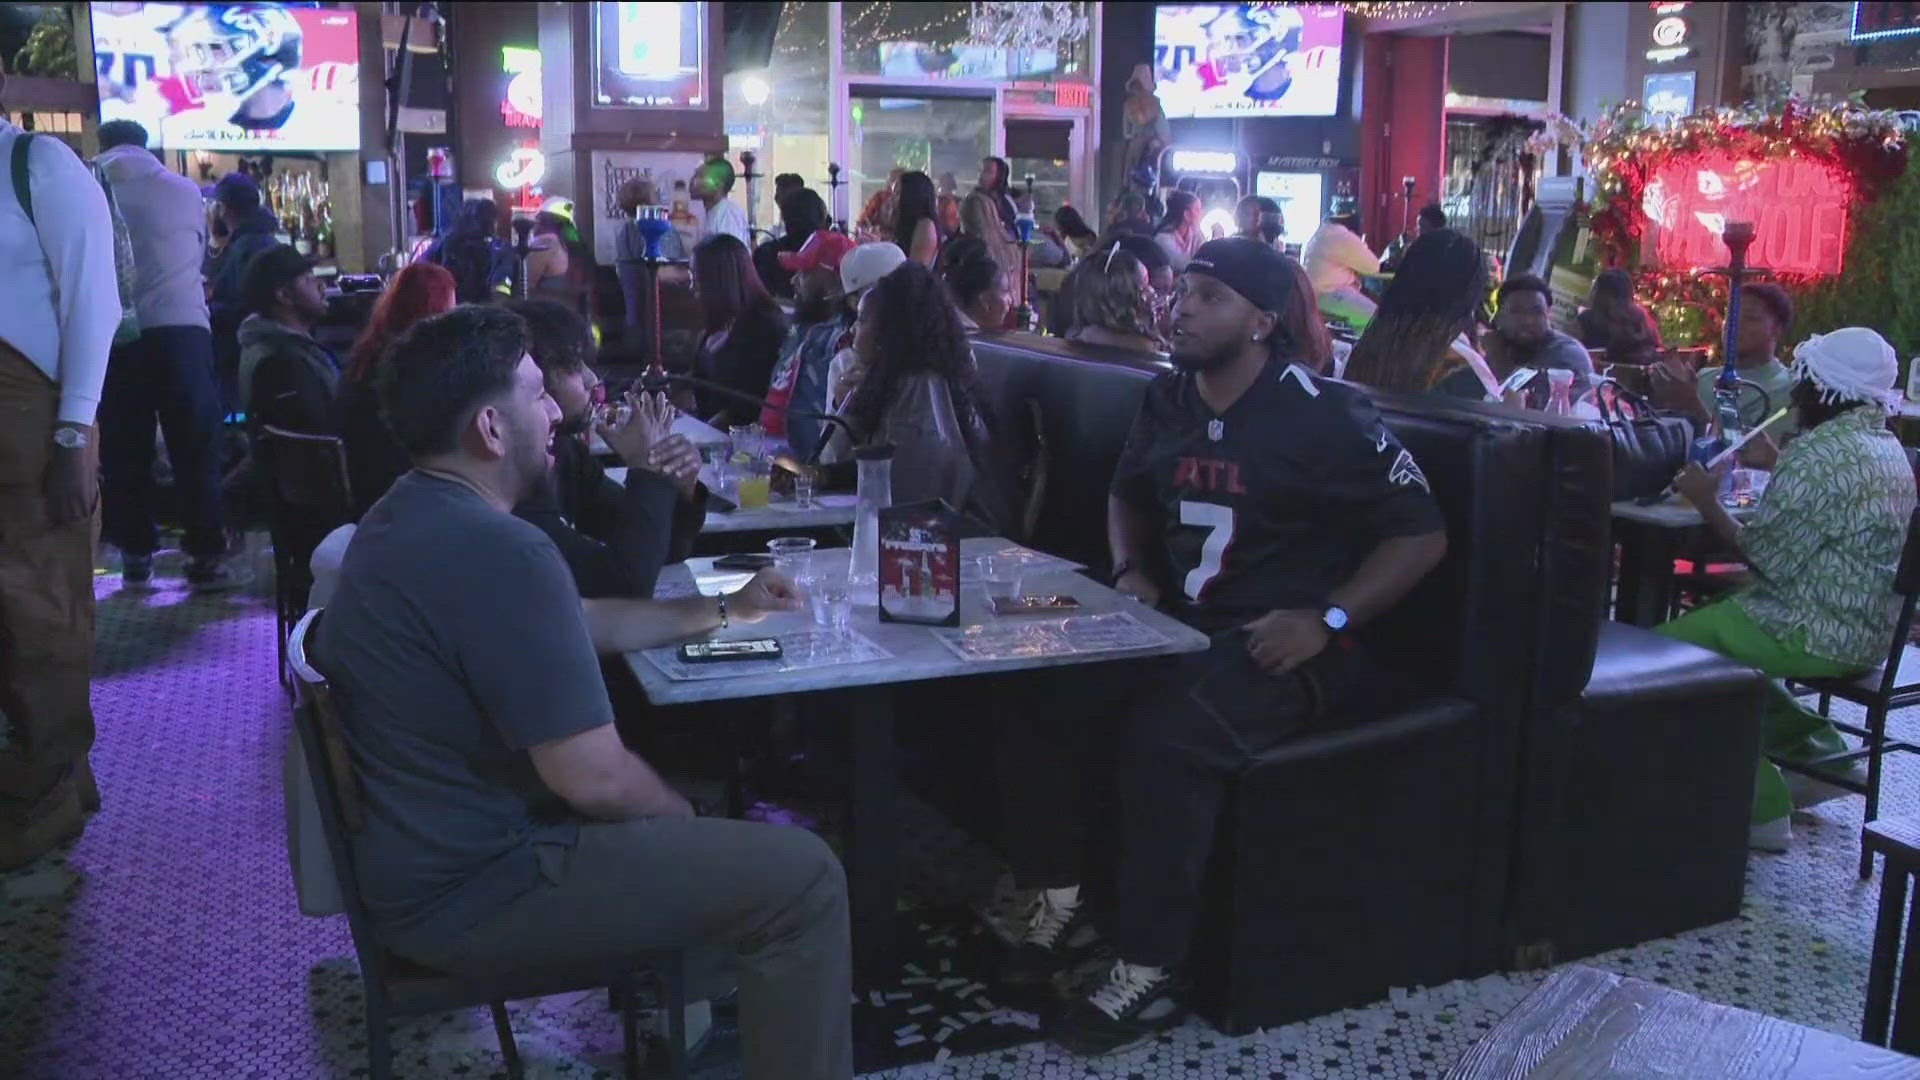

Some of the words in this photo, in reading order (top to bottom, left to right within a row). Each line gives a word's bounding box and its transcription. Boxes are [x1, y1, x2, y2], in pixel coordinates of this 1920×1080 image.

[1267, 156, 1315, 169] MYSTERY
[1318, 158, 1341, 169] BOX
[1172, 455, 1247, 496] ATL
[1180, 500, 1237, 603] 7
